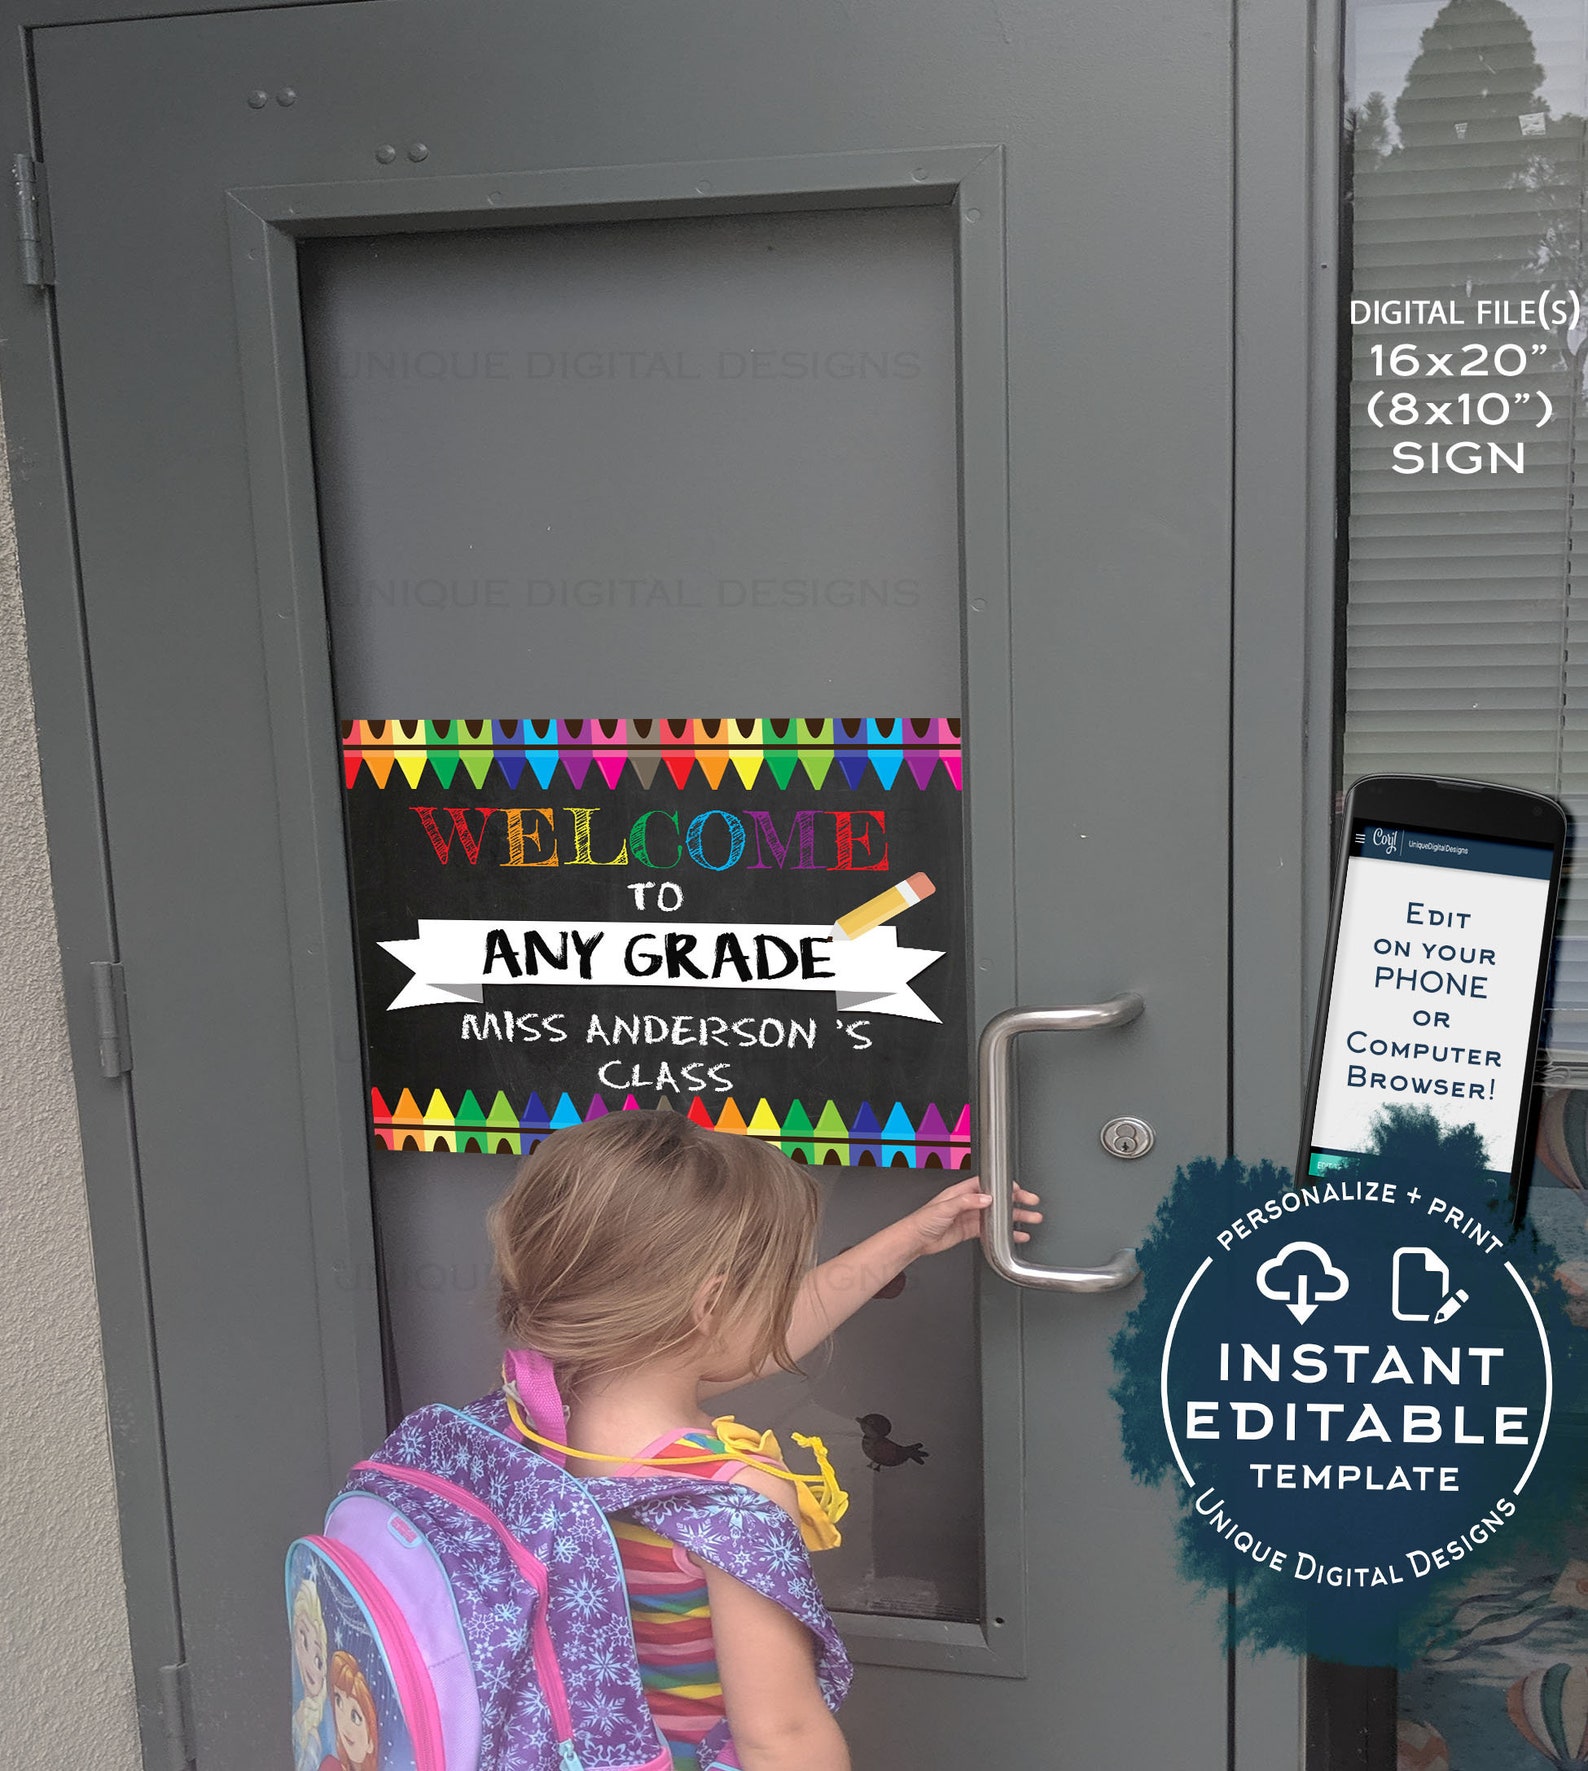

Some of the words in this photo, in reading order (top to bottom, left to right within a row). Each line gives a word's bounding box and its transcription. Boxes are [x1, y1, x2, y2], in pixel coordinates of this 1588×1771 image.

[408, 806, 890, 872] WELCOME
[627, 881, 684, 913] TO
[482, 929, 605, 980] ANY
[623, 932, 837, 983] GRADE
[1373, 938, 1411, 958] ON
[1422, 942, 1496, 966] YOUR
[1374, 966, 1488, 999] PHONE
[461, 1010, 568, 1043] MISS
[586, 1013, 817, 1049] ANDERSON
[1412, 1010, 1450, 1029] OR
[597, 1059, 734, 1093] CLASS
